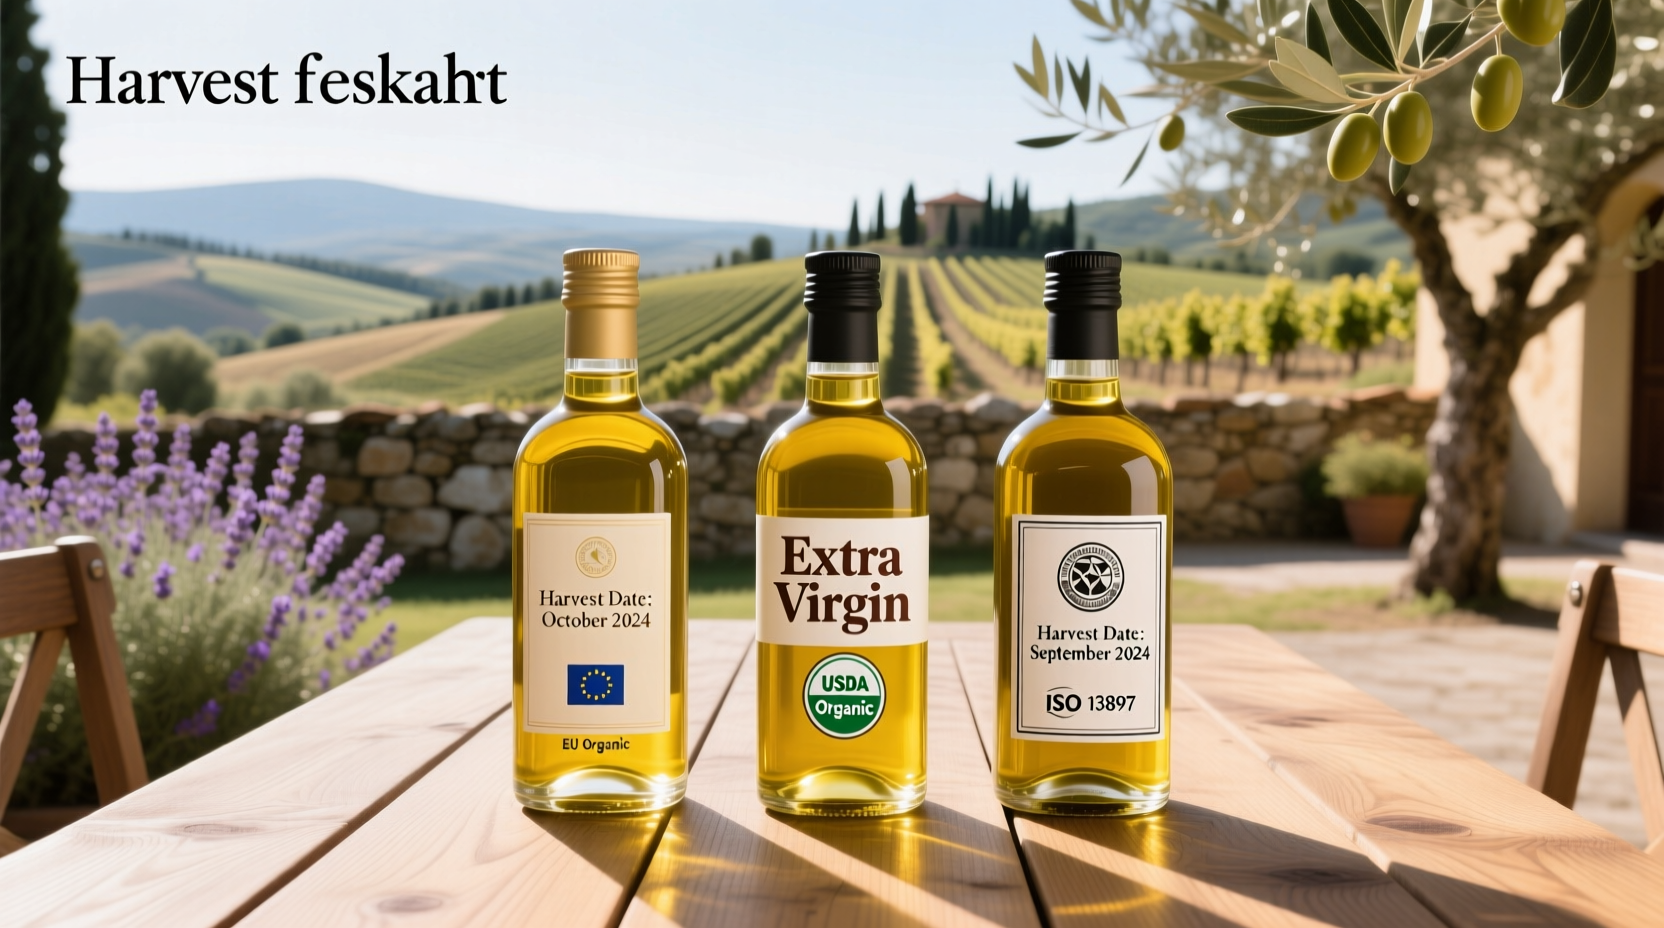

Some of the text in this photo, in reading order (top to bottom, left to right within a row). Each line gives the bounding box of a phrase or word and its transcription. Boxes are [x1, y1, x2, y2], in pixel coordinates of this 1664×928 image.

[780, 535, 903, 577] Extra
[539, 590, 652, 607] Harvest Date:
[773, 581, 911, 635] Virgin
[541, 611, 651, 628] October 2024
[1037, 625, 1145, 641] Harvest Date:
[1030, 644, 1150, 664] September 2024
[821, 674, 870, 692] USDA
[815, 699, 874, 720] Organic
[1046, 693, 1136, 712] ISO 13897
[562, 736, 630, 753] EU Organic
